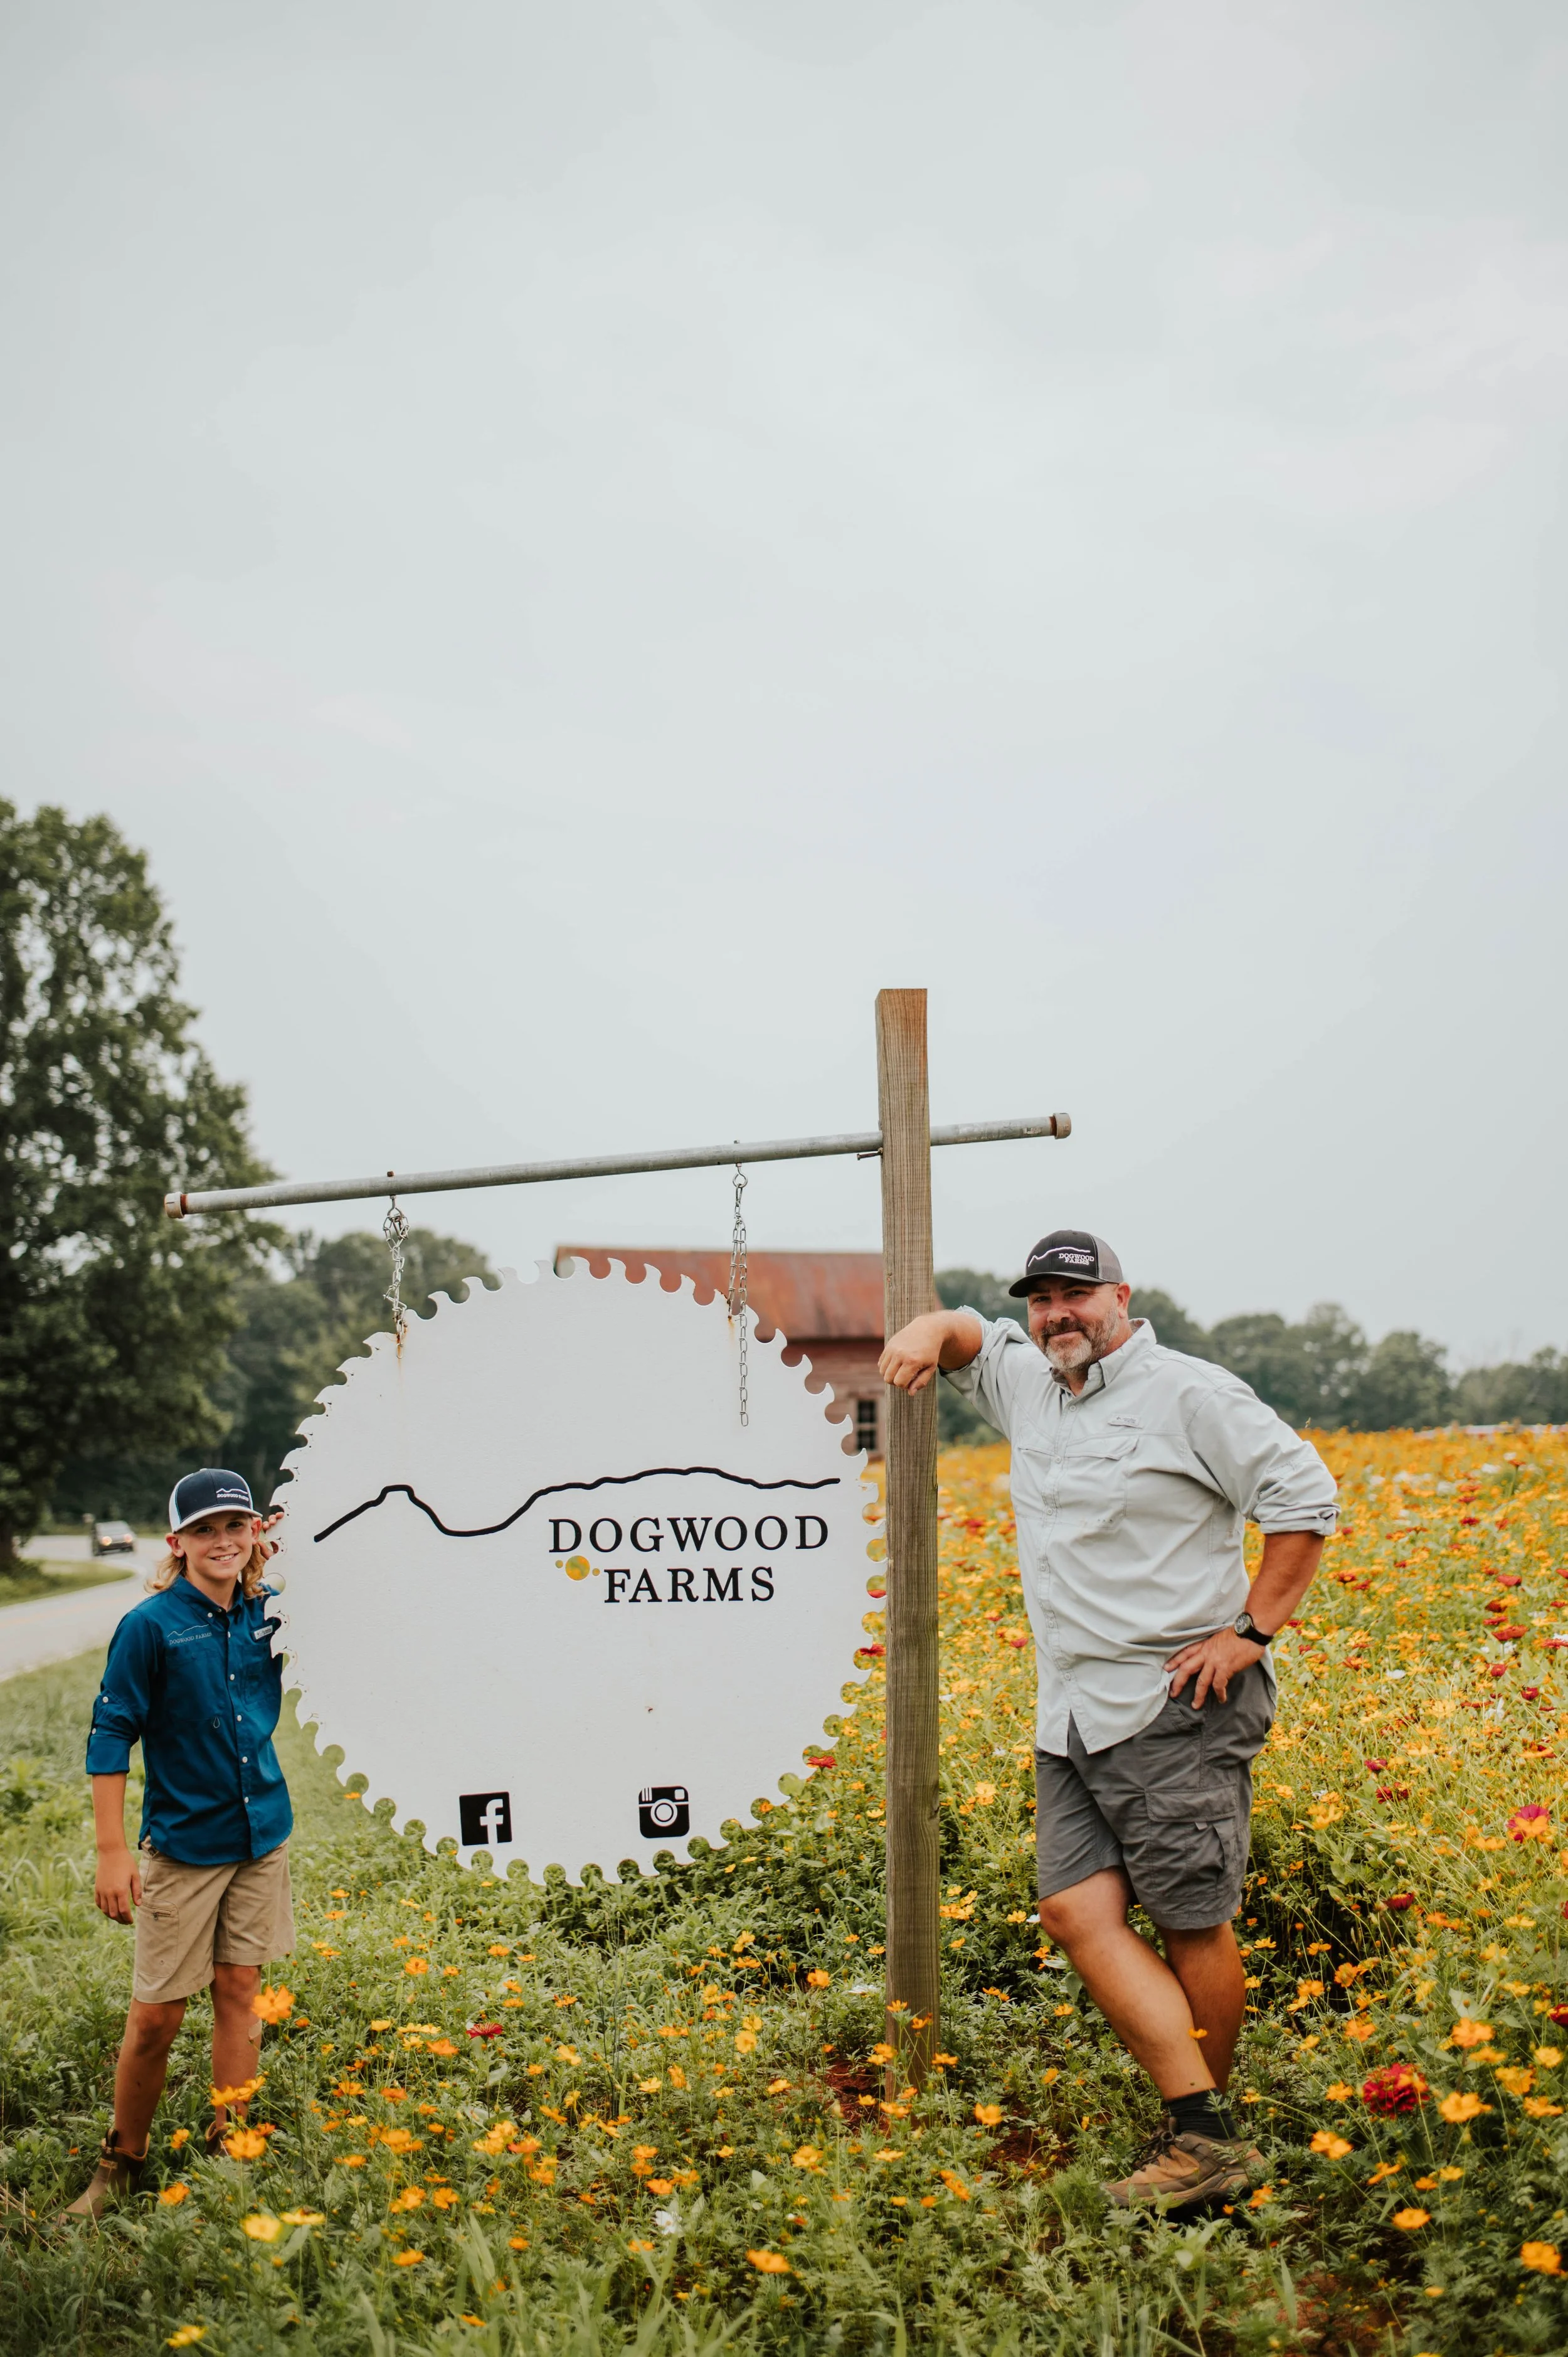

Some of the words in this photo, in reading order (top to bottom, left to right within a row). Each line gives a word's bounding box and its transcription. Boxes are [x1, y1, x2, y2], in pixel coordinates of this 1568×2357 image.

[1058, 1253, 1094, 1262] DOGWOOD
[1064, 1257, 1089, 1265] FARMS
[549, 1515, 829, 1553] DOGWOOD
[603, 1566, 775, 1604] FARMS
